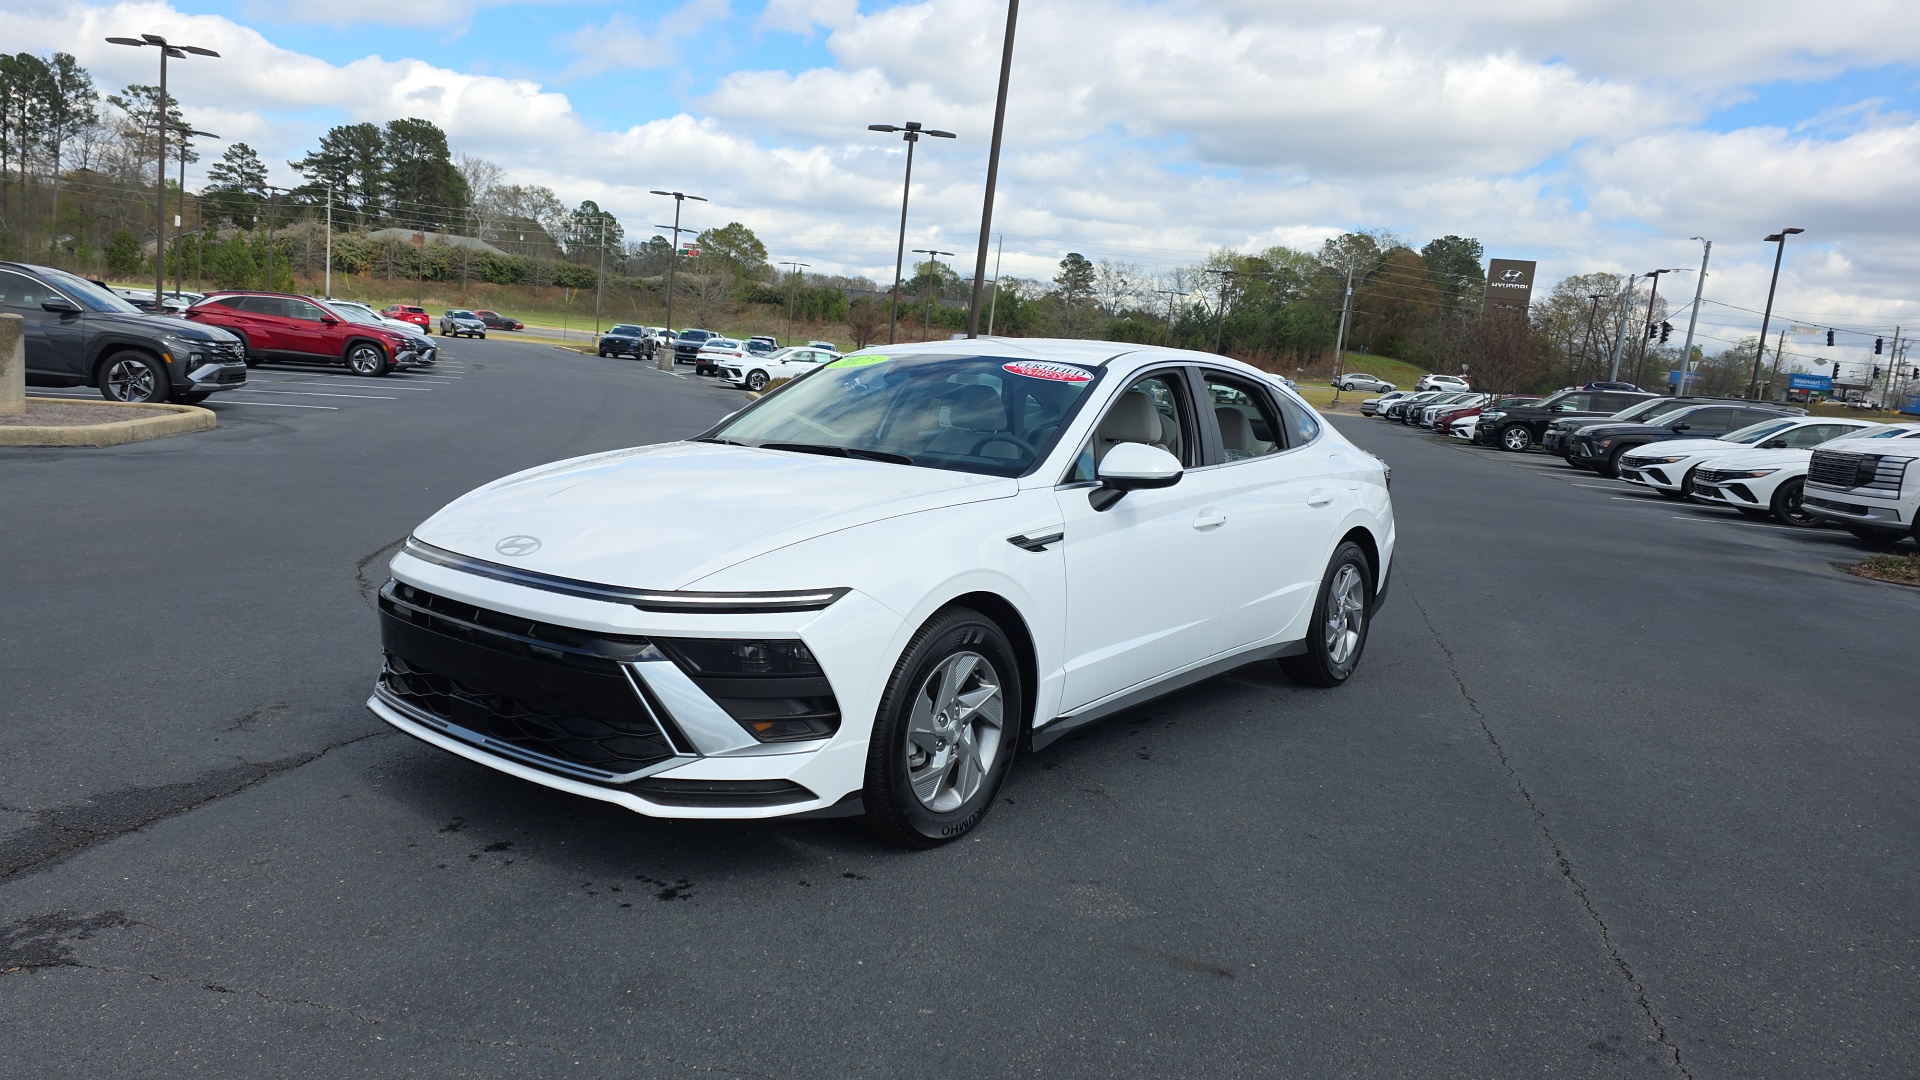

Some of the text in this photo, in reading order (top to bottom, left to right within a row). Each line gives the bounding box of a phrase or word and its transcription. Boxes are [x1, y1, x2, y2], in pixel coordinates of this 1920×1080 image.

[1491, 282, 1529, 290] HYUNDAI
[1015, 362, 1087, 377] CERTIFIED
[1794, 378, 1821, 386] Walmart
[941, 807, 983, 836] KUMHO
